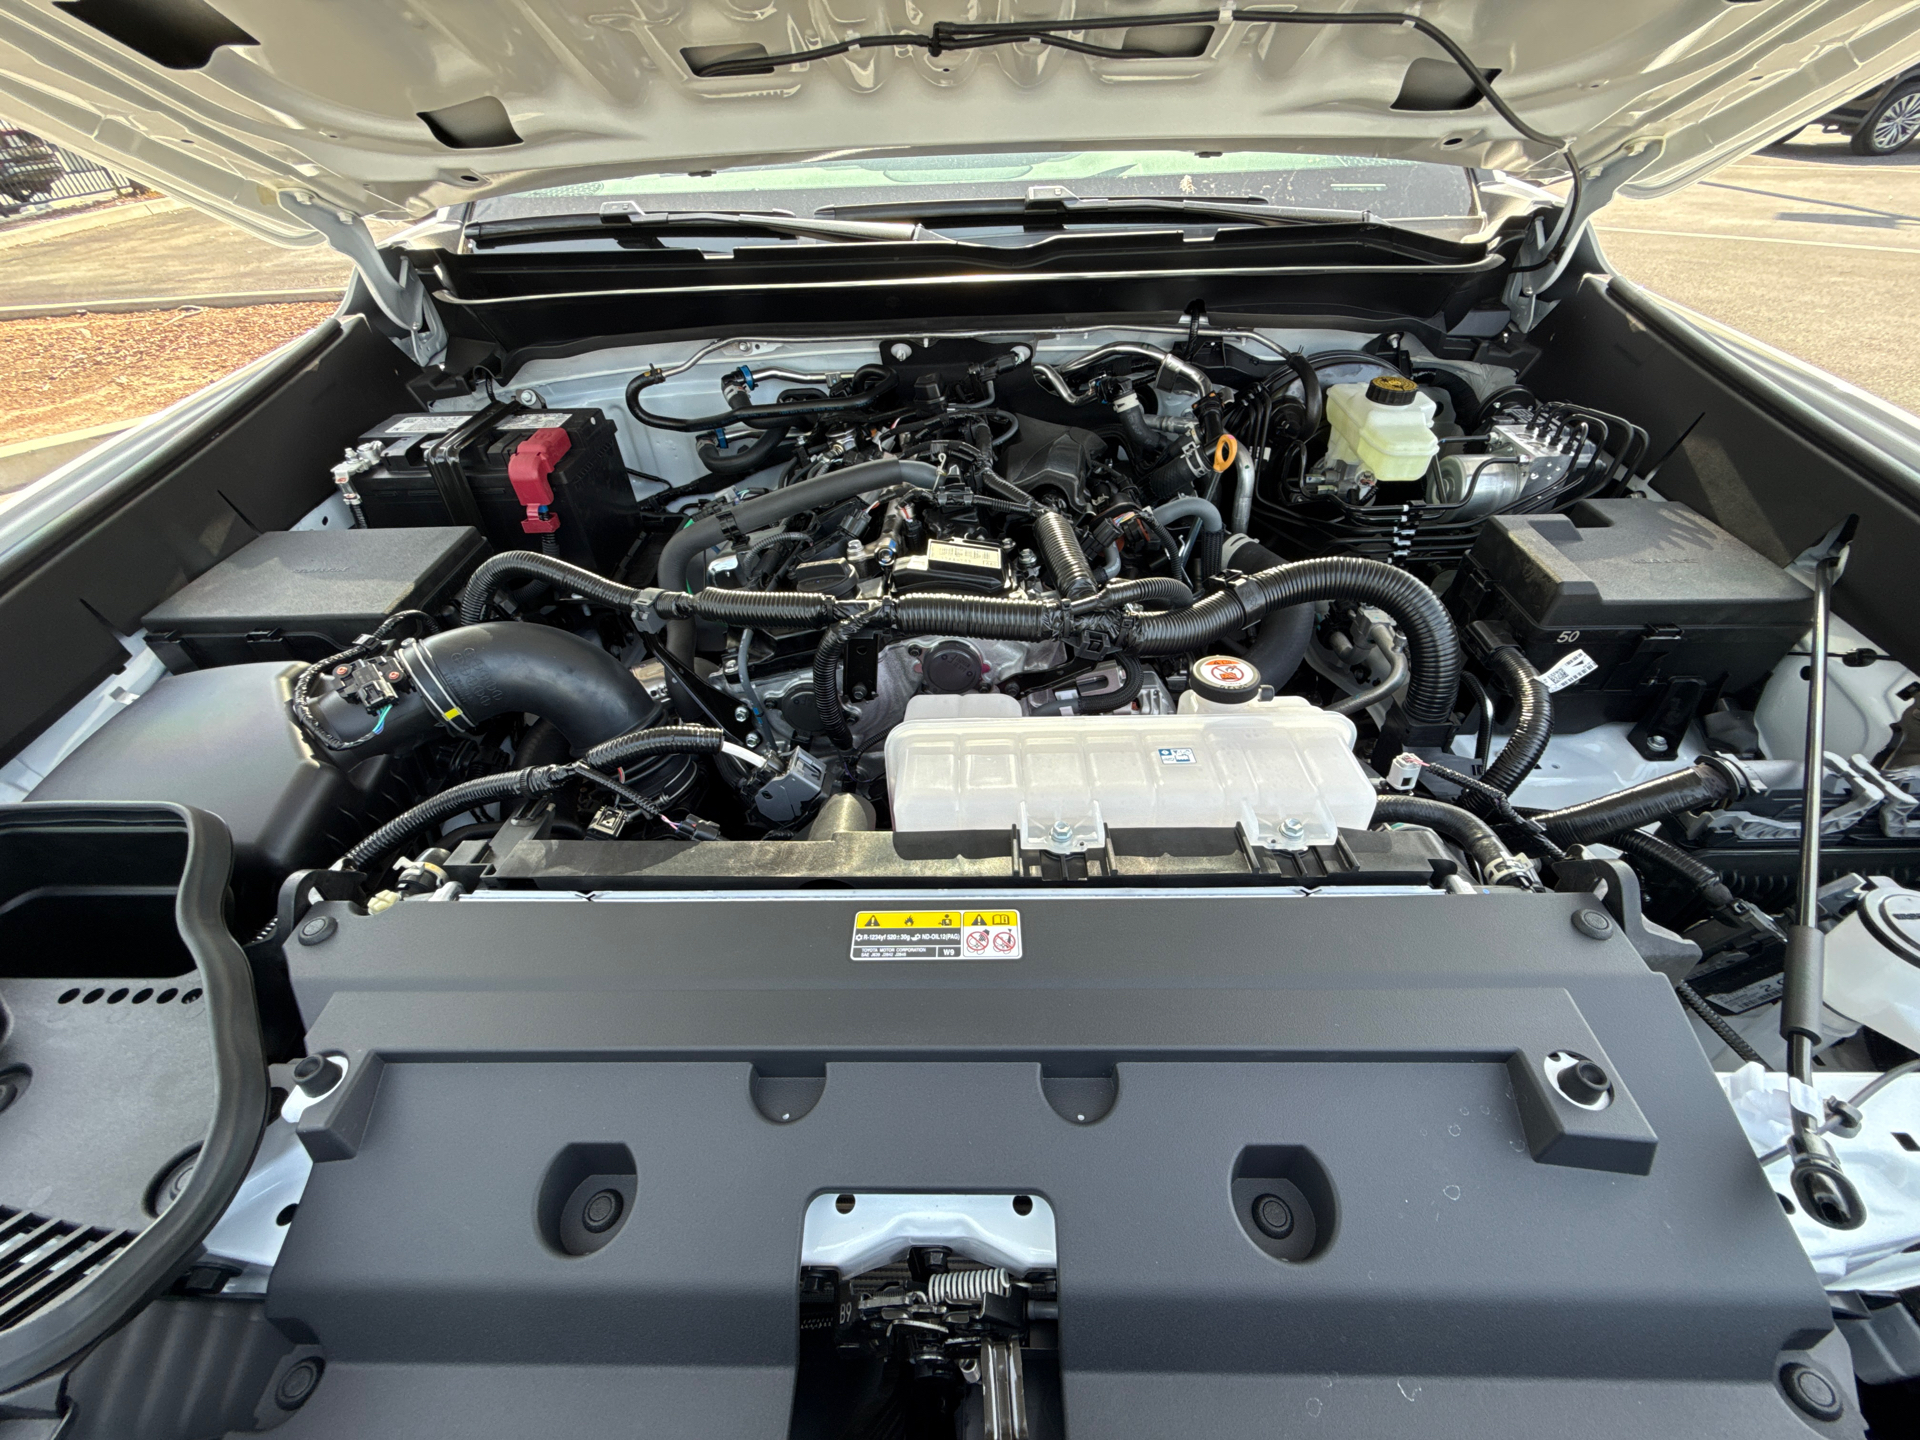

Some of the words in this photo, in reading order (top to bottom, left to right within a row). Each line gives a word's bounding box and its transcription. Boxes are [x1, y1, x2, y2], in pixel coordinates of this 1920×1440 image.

[1556, 630, 1581, 643] 50
[864, 933, 887, 942] R-1234yf
[886, 933, 911, 942] 520±30g
[839, 1301, 853, 1325] B9
